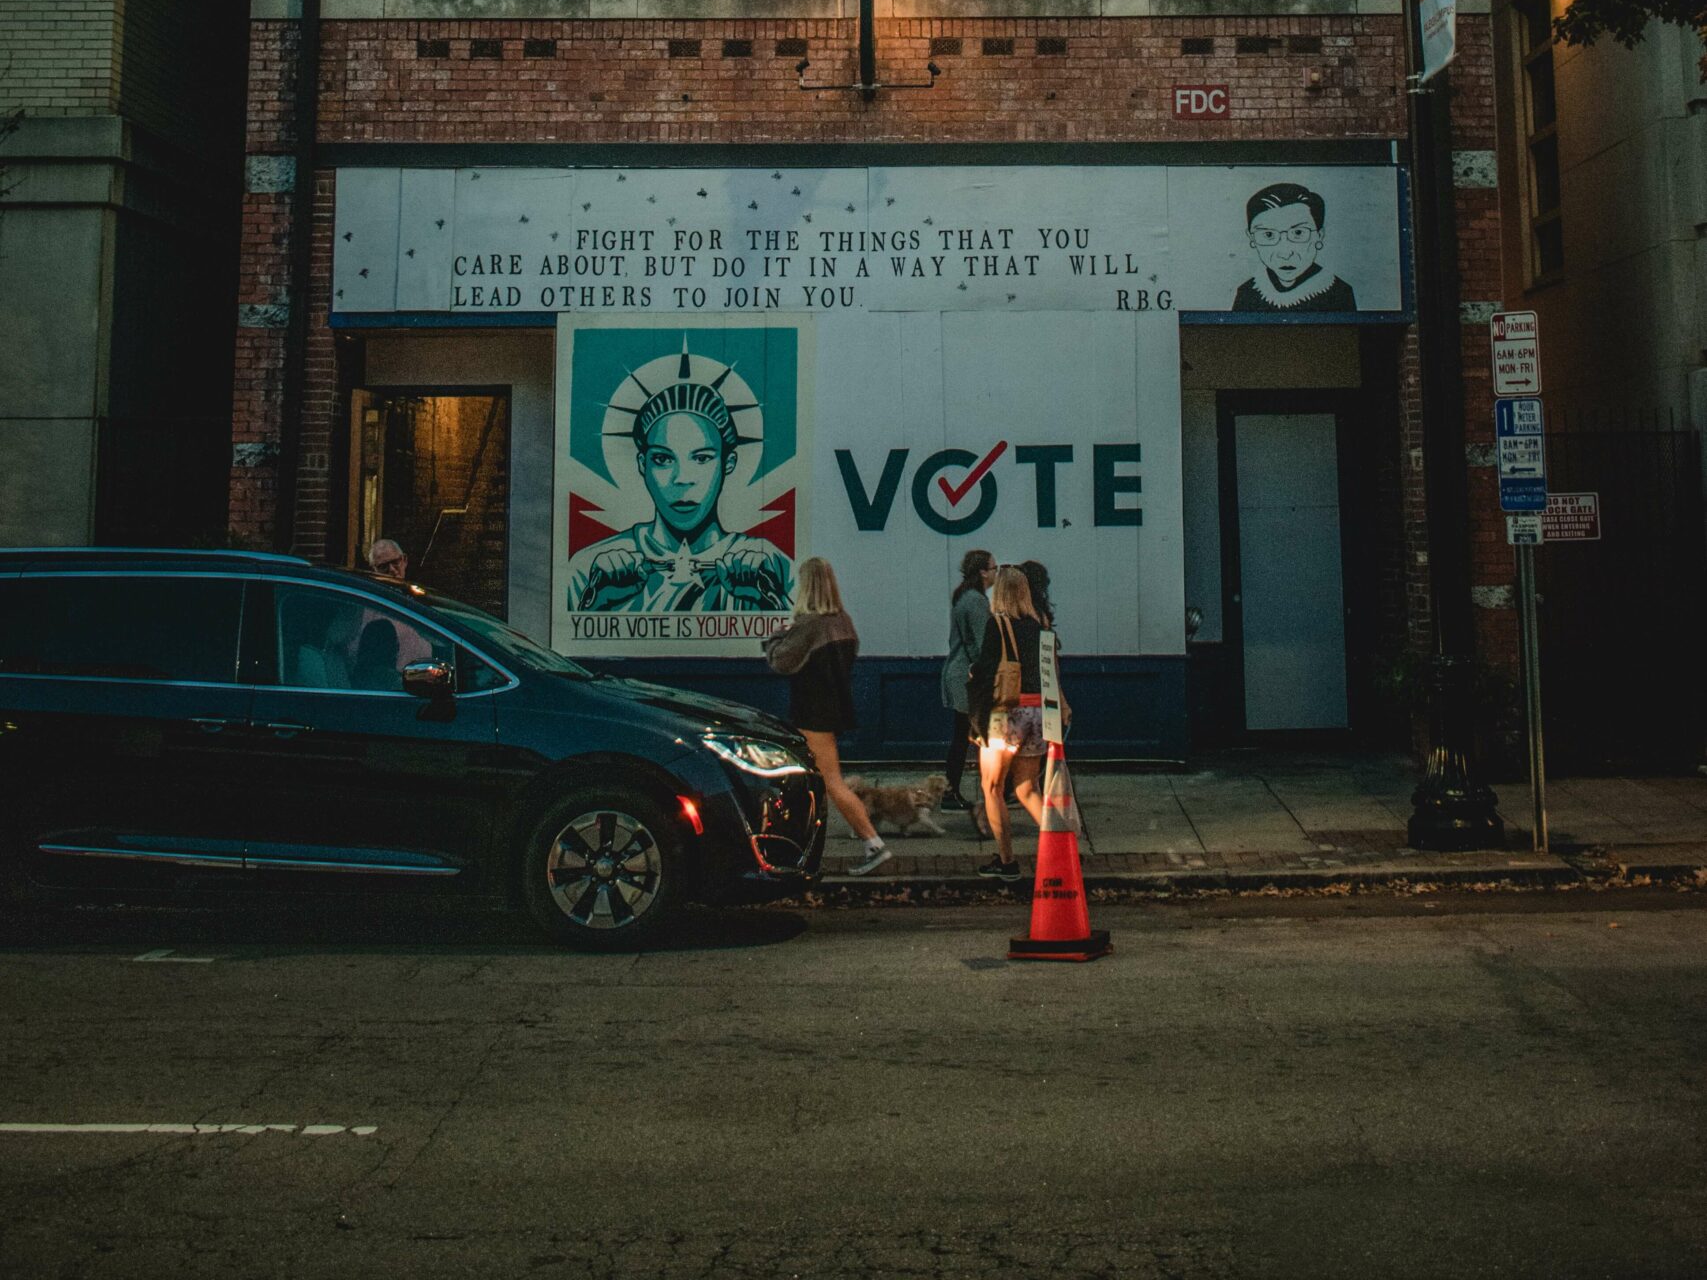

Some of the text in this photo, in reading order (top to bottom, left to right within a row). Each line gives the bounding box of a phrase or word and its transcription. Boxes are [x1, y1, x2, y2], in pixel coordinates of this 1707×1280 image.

[1175, 89, 1226, 114] FDC
[576, 228, 1090, 252] FIGHT FOR THE THINGS THAT YOU
[453, 254, 523, 277] CARE
[644, 255, 696, 277] BUT
[712, 256, 746, 278] DO
[763, 256, 791, 278] IT
[809, 256, 837, 278] IN
[855, 256, 870, 278] A
[890, 255, 946, 278] WAY
[963, 255, 1040, 277] THAT
[1068, 254, 1139, 276] WILL
[453, 285, 863, 309] LEAD OTHERS TO JOIN YOU.
[1493, 321, 1535, 337] NO PARKING
[1518, 402, 1534, 411] HOUR
[1515, 423, 1541, 433] PARKING
[834, 442, 1143, 536] VOTE
[1562, 497, 1580, 505] NOT
[1570, 505, 1593, 514] GATE
[572, 616, 790, 638] YOUR VOTE IS YOUR VOICE
